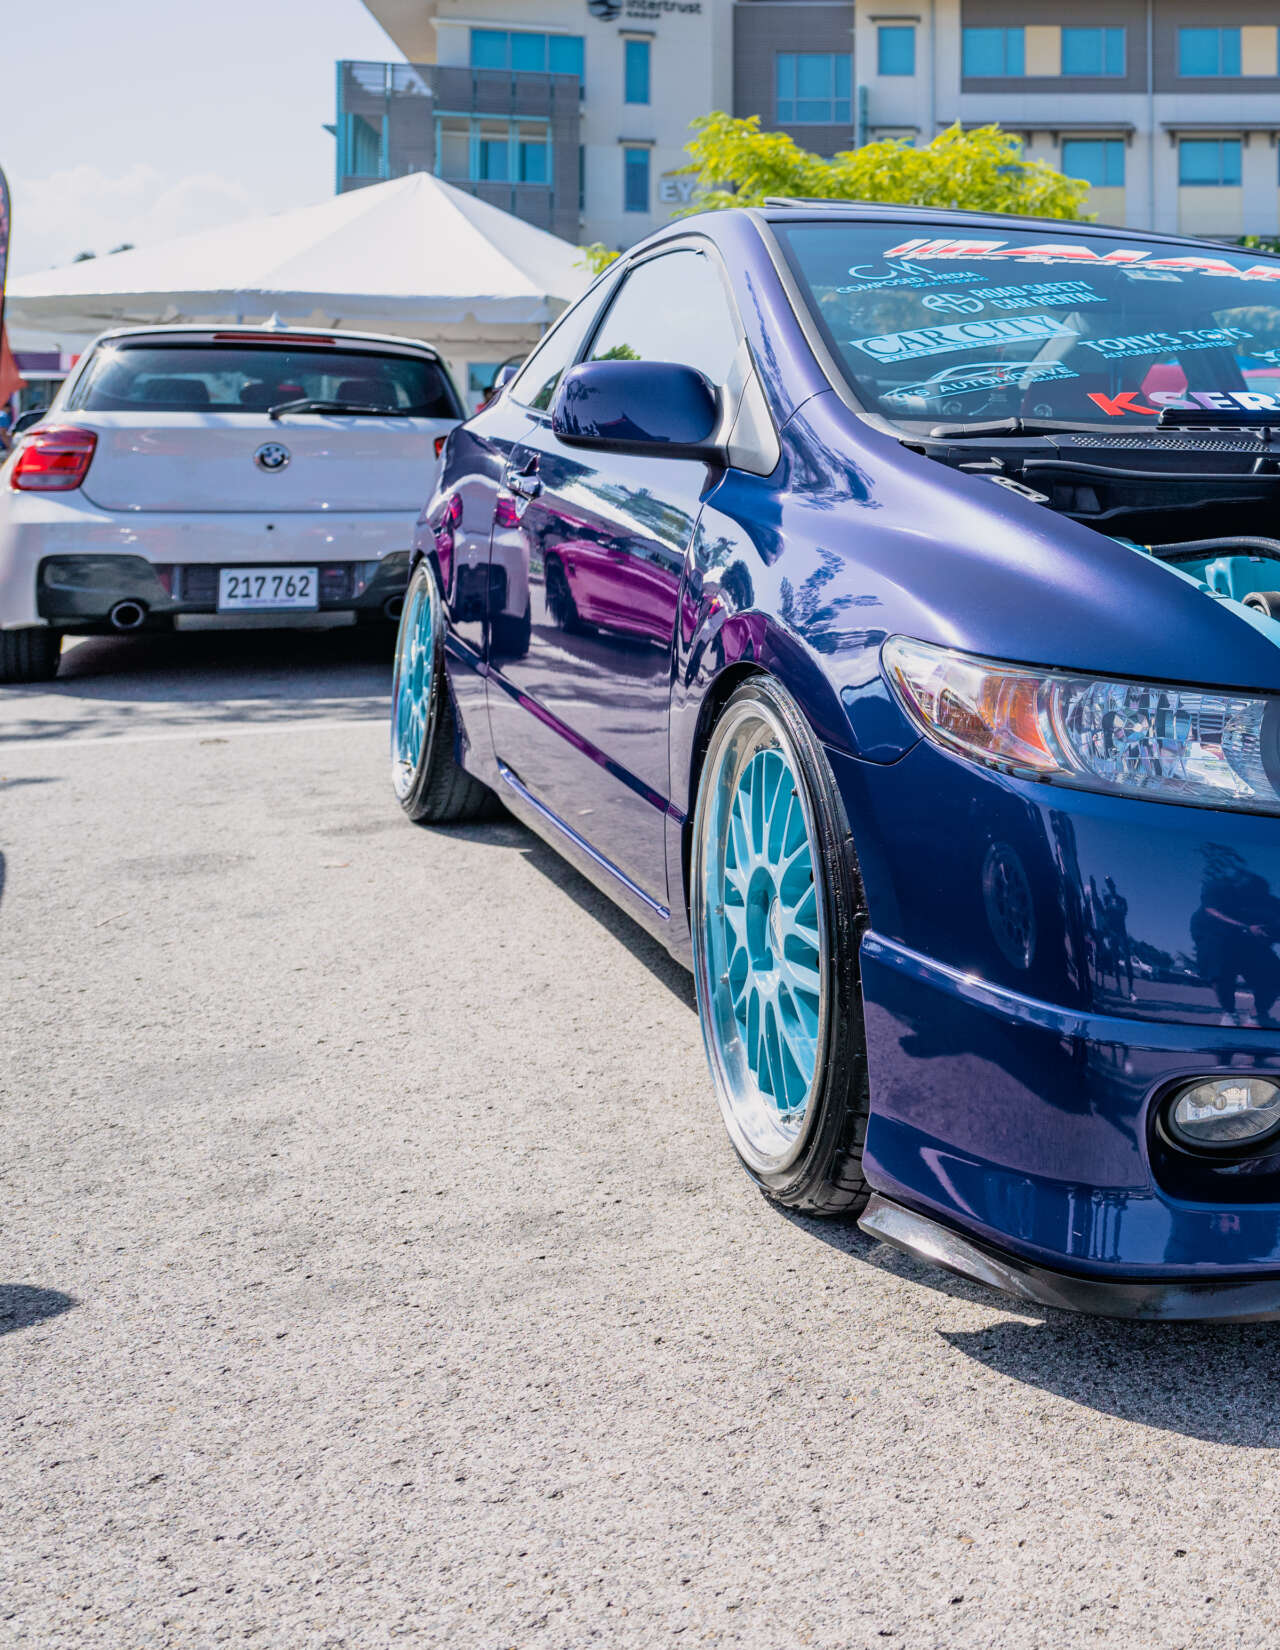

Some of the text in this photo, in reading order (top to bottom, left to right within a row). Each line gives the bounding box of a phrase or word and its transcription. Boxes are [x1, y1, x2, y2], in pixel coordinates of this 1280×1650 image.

[660, 181, 695, 202] EY
[836, 271, 982, 294] COMPOSED MEDIA
[968, 280, 1094, 300] ROAD SAFETY
[990, 292, 1107, 310] CAR RENTAL
[862, 329, 962, 355] CAR
[958, 316, 1059, 340] CITY
[1078, 332, 1183, 353] TONY'S
[1102, 344, 1185, 359] AUTOMOTIVE
[940, 366, 1074, 393] AUTOMOTIVE
[227, 575, 310, 599] 217 762
